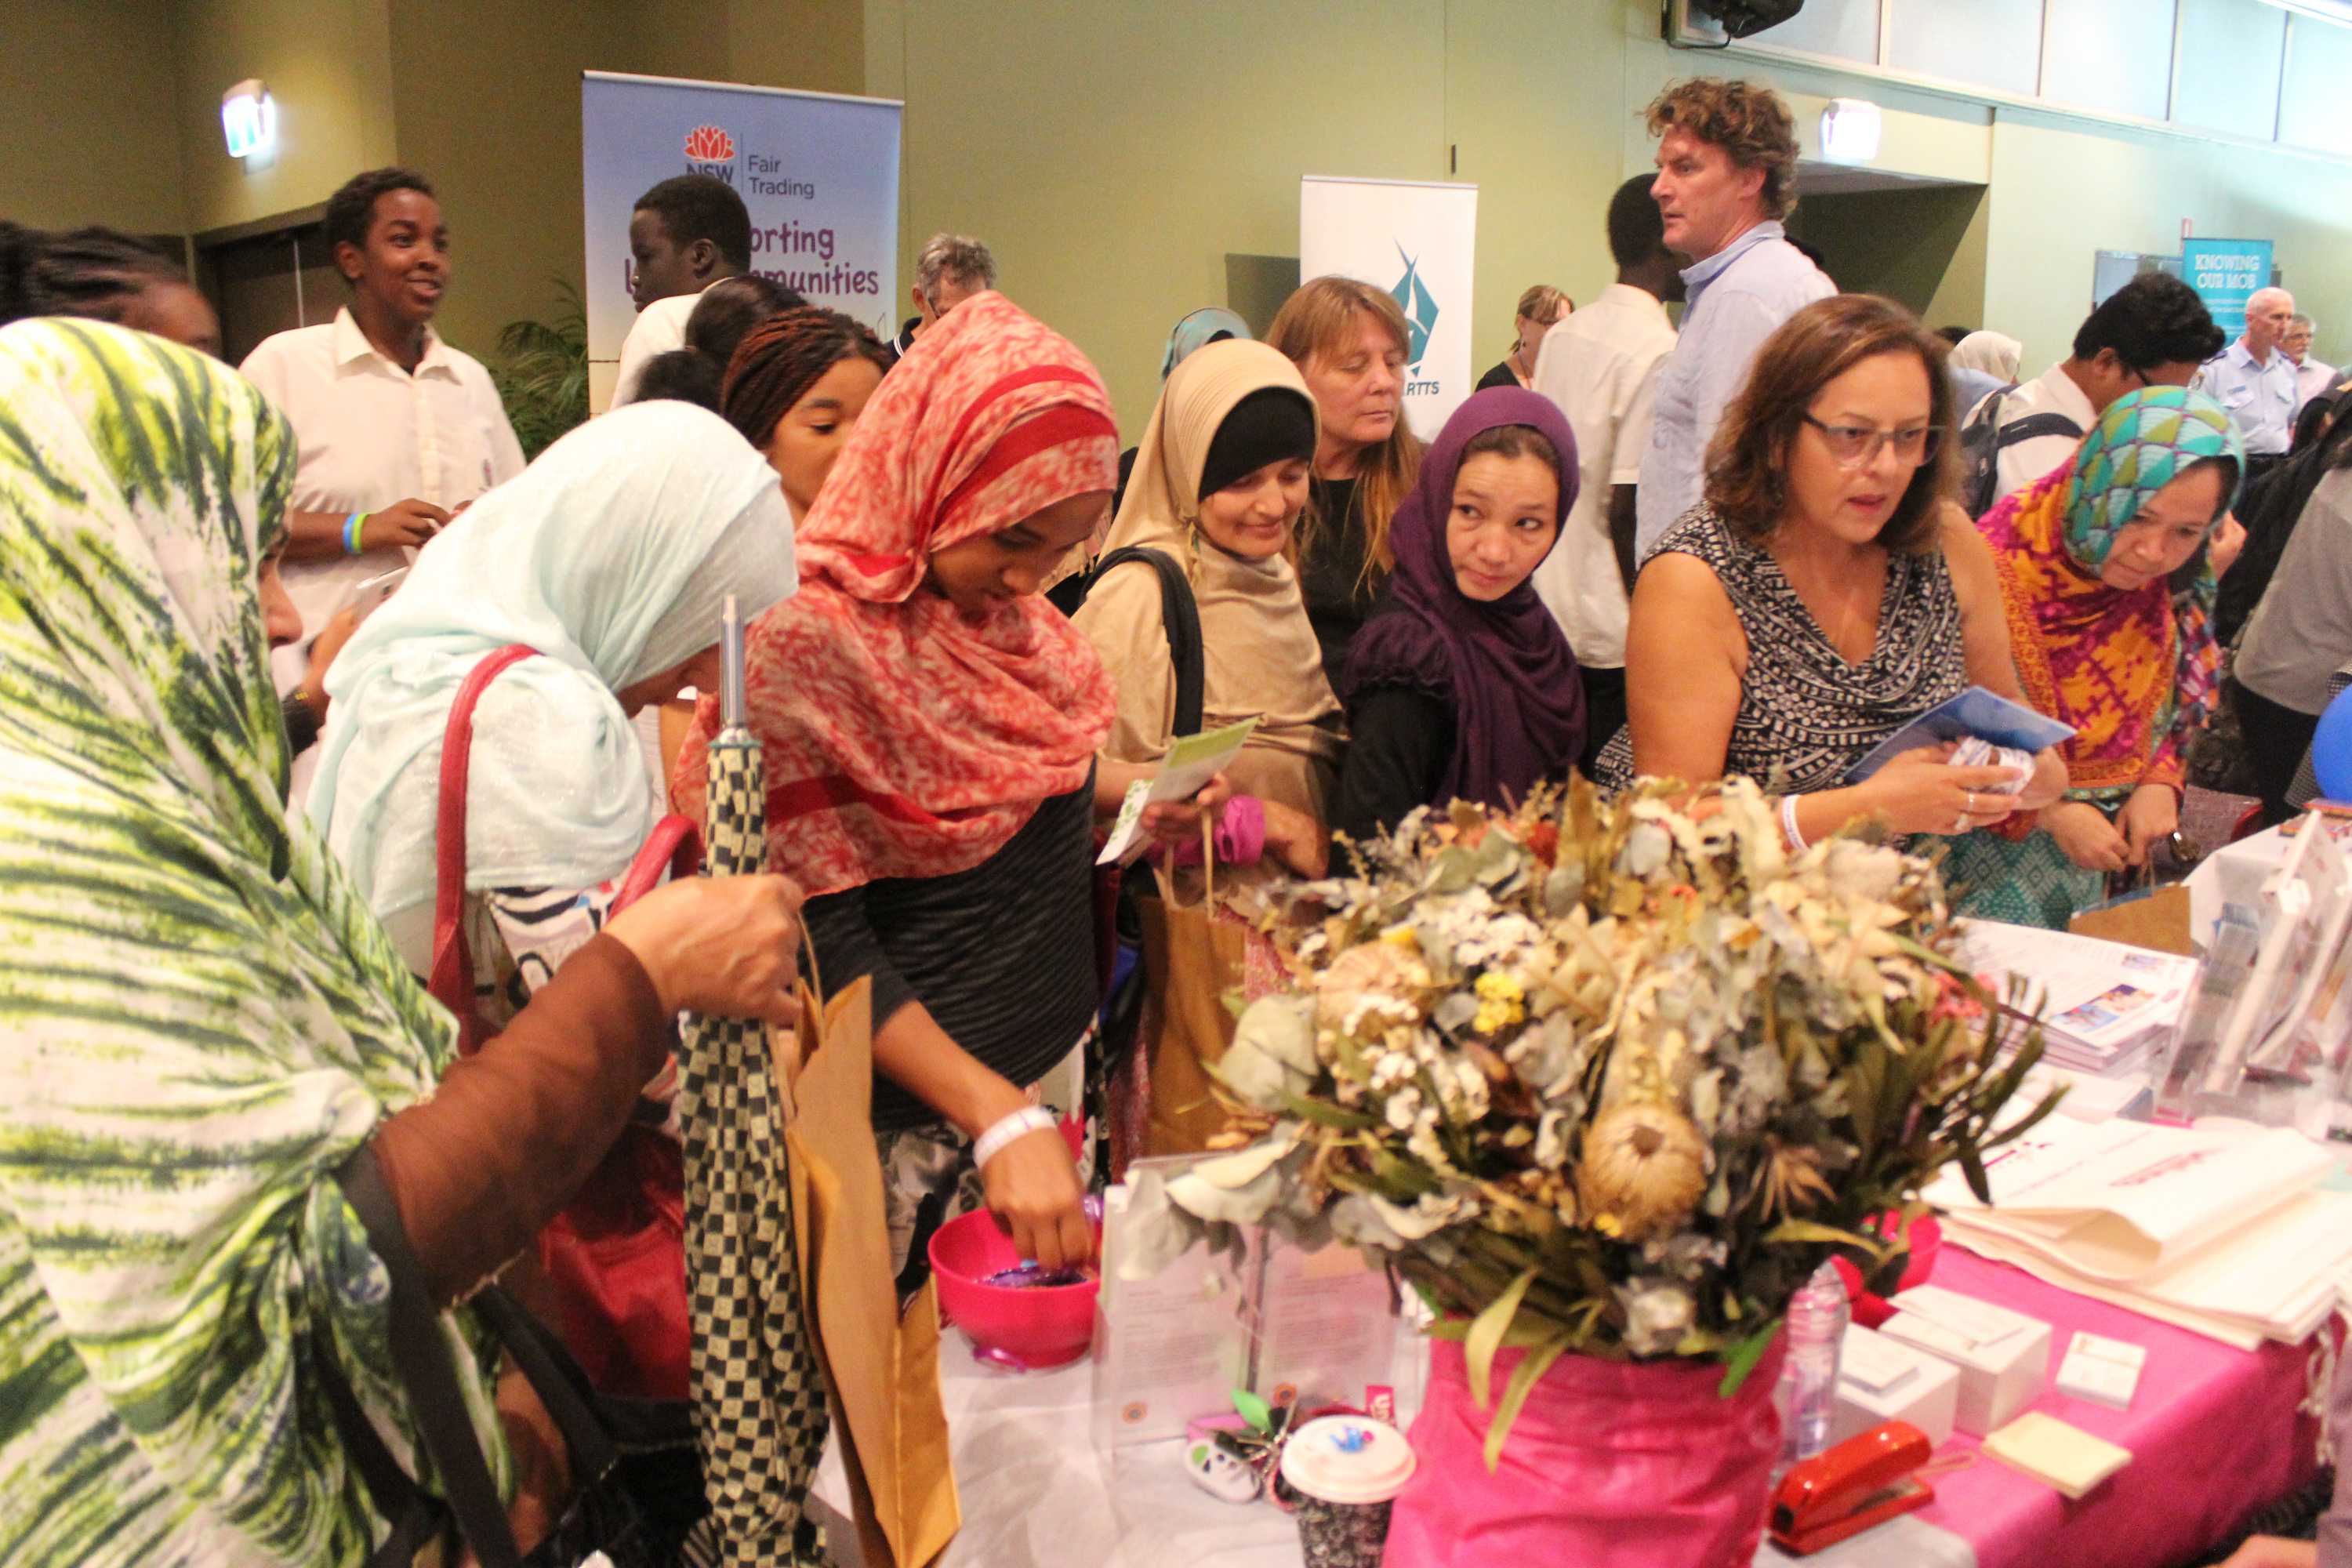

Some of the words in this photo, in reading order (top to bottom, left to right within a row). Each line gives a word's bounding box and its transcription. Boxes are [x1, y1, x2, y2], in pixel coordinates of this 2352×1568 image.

[749, 154, 782, 172] Fair
[749, 176, 815, 200] Trading
[750, 220, 834, 260] orting
[2195, 253, 2260, 270] KNOWING
[2197, 272, 2223, 289] OUR
[2227, 273, 2257, 289] MOB
[1406, 380, 1439, 396] RTTS
